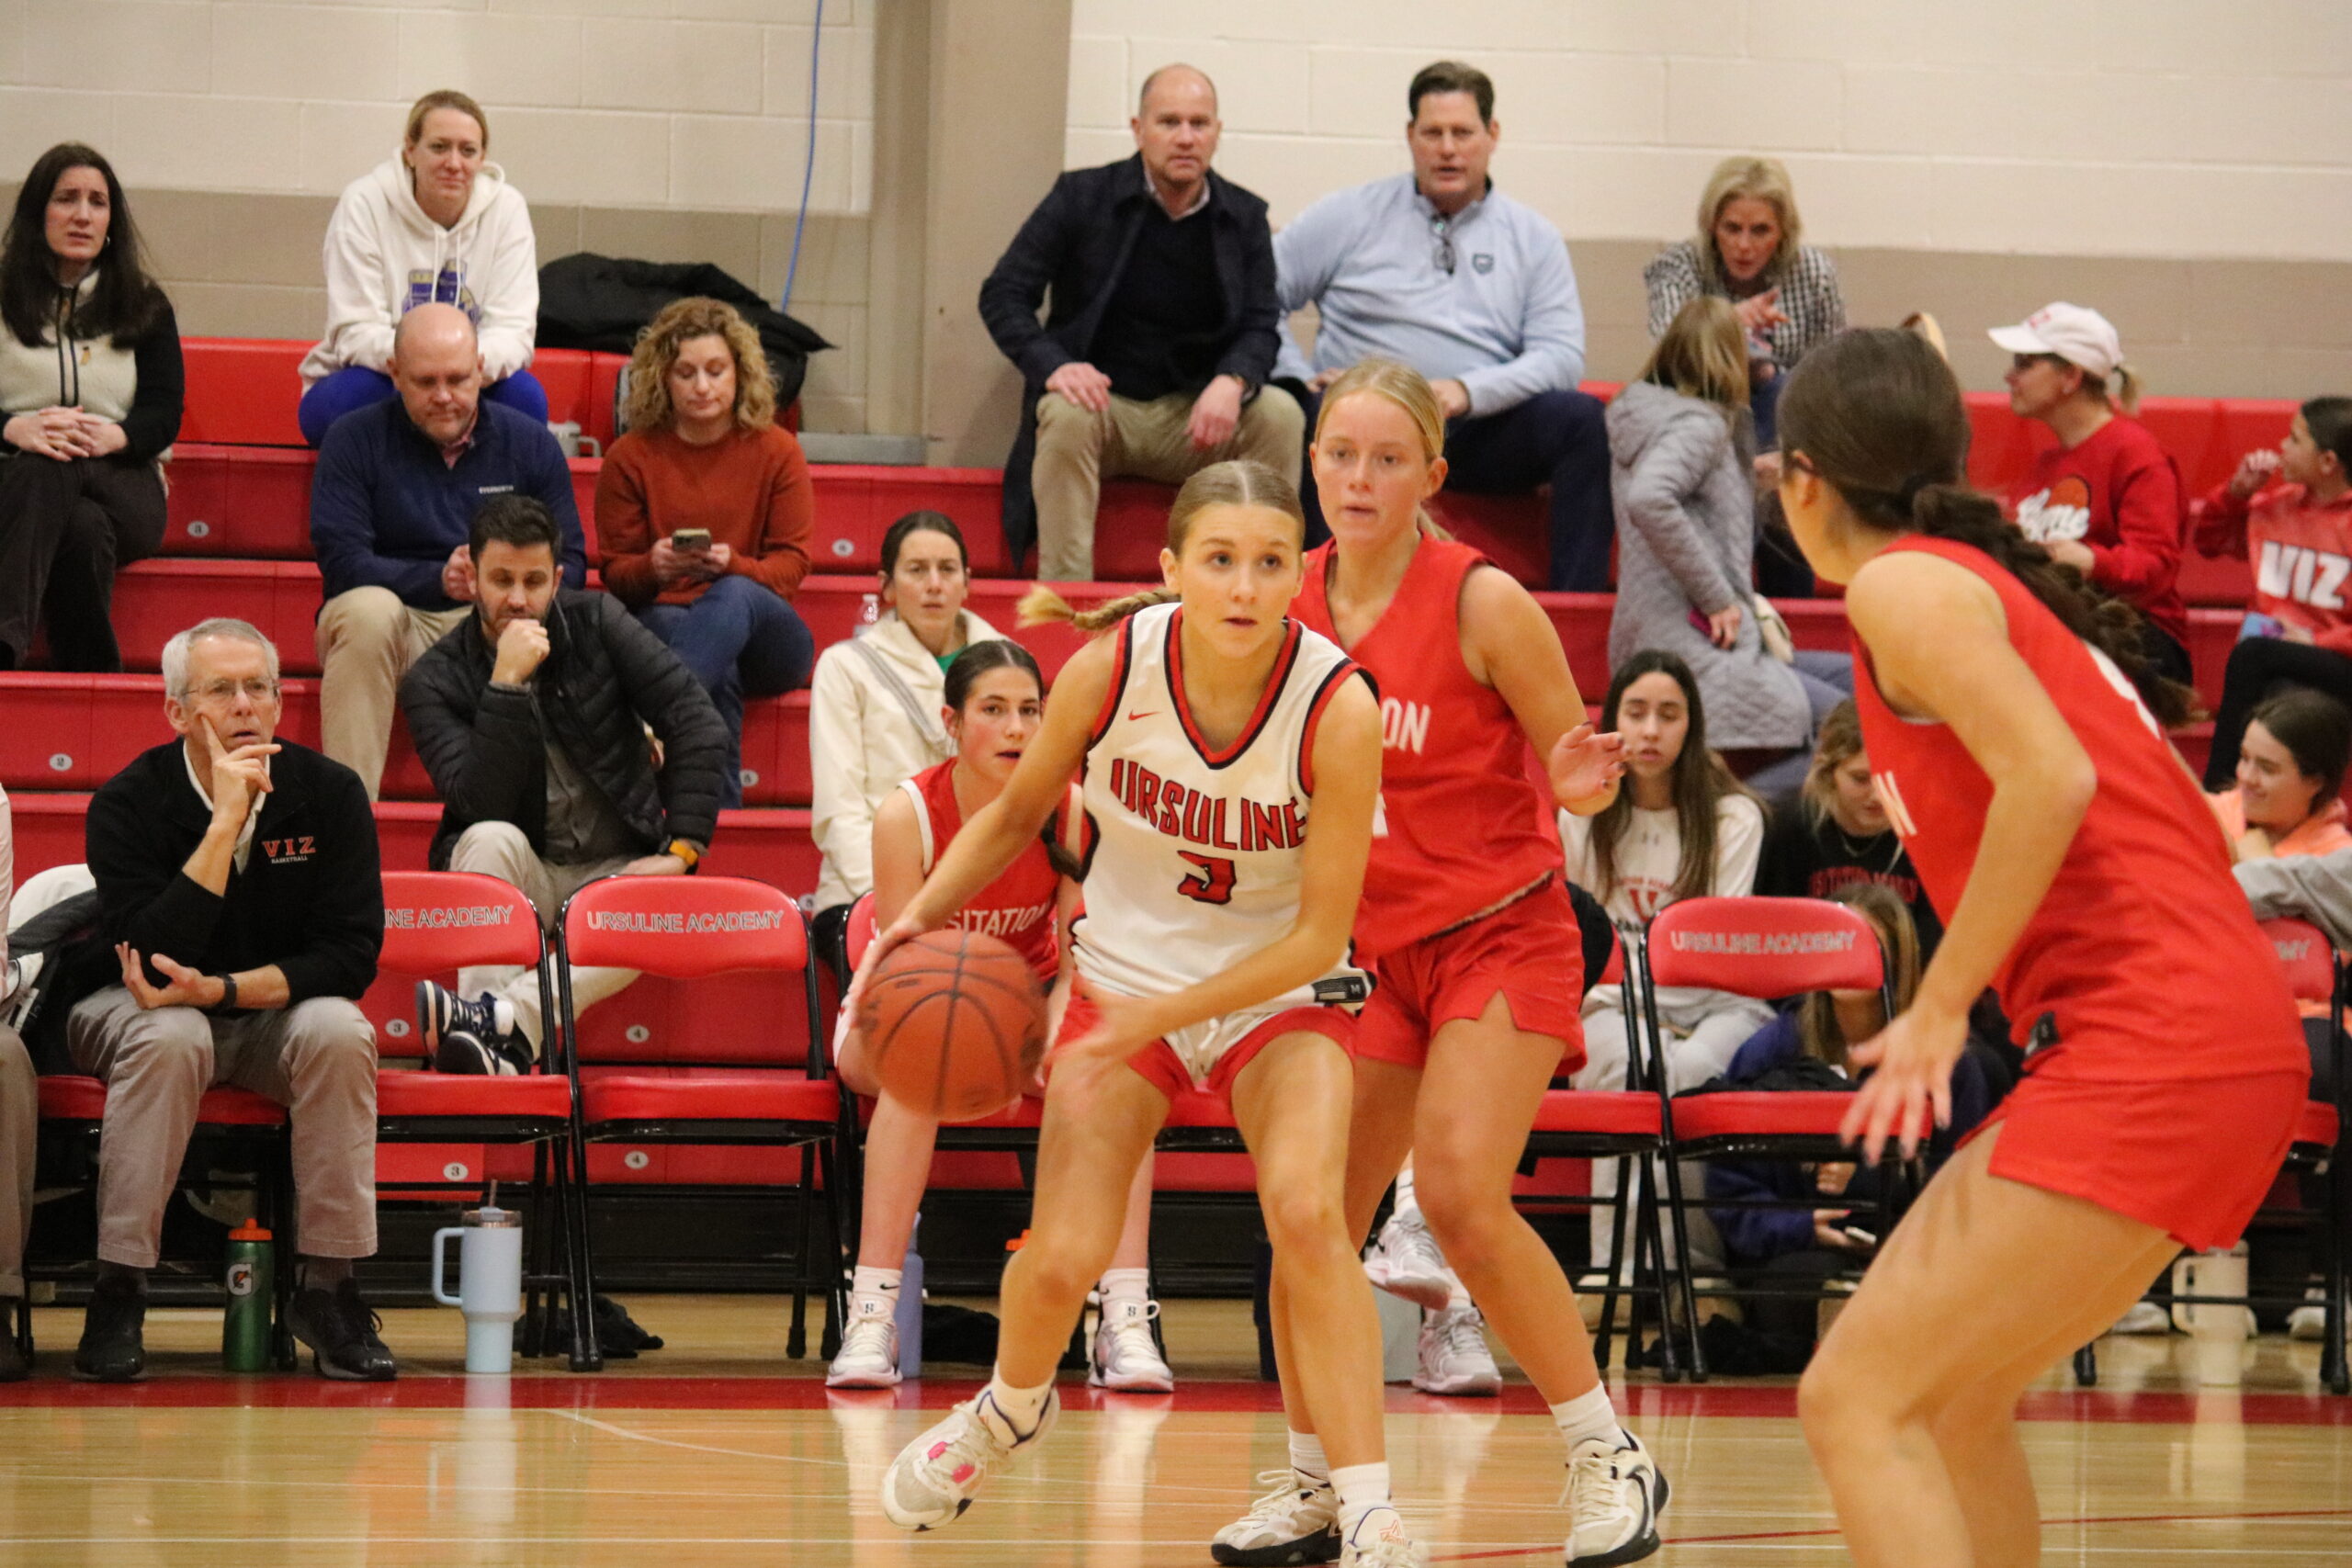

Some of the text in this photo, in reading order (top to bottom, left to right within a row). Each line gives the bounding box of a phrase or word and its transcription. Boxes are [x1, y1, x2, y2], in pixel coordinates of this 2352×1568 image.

[2257, 540, 2351, 609] VIZ
[1110, 759, 1306, 852] URSULINE
[262, 836, 316, 857] VIZ
[271, 855, 308, 864] BASKETBALL
[1177, 850, 1237, 906] 3
[416, 905, 514, 929] ACADEMY
[587, 910, 783, 932] URSULINE ACADEMY
[1670, 931, 1856, 953] URSULINE ACADEMY
[227, 1263, 252, 1295] G
